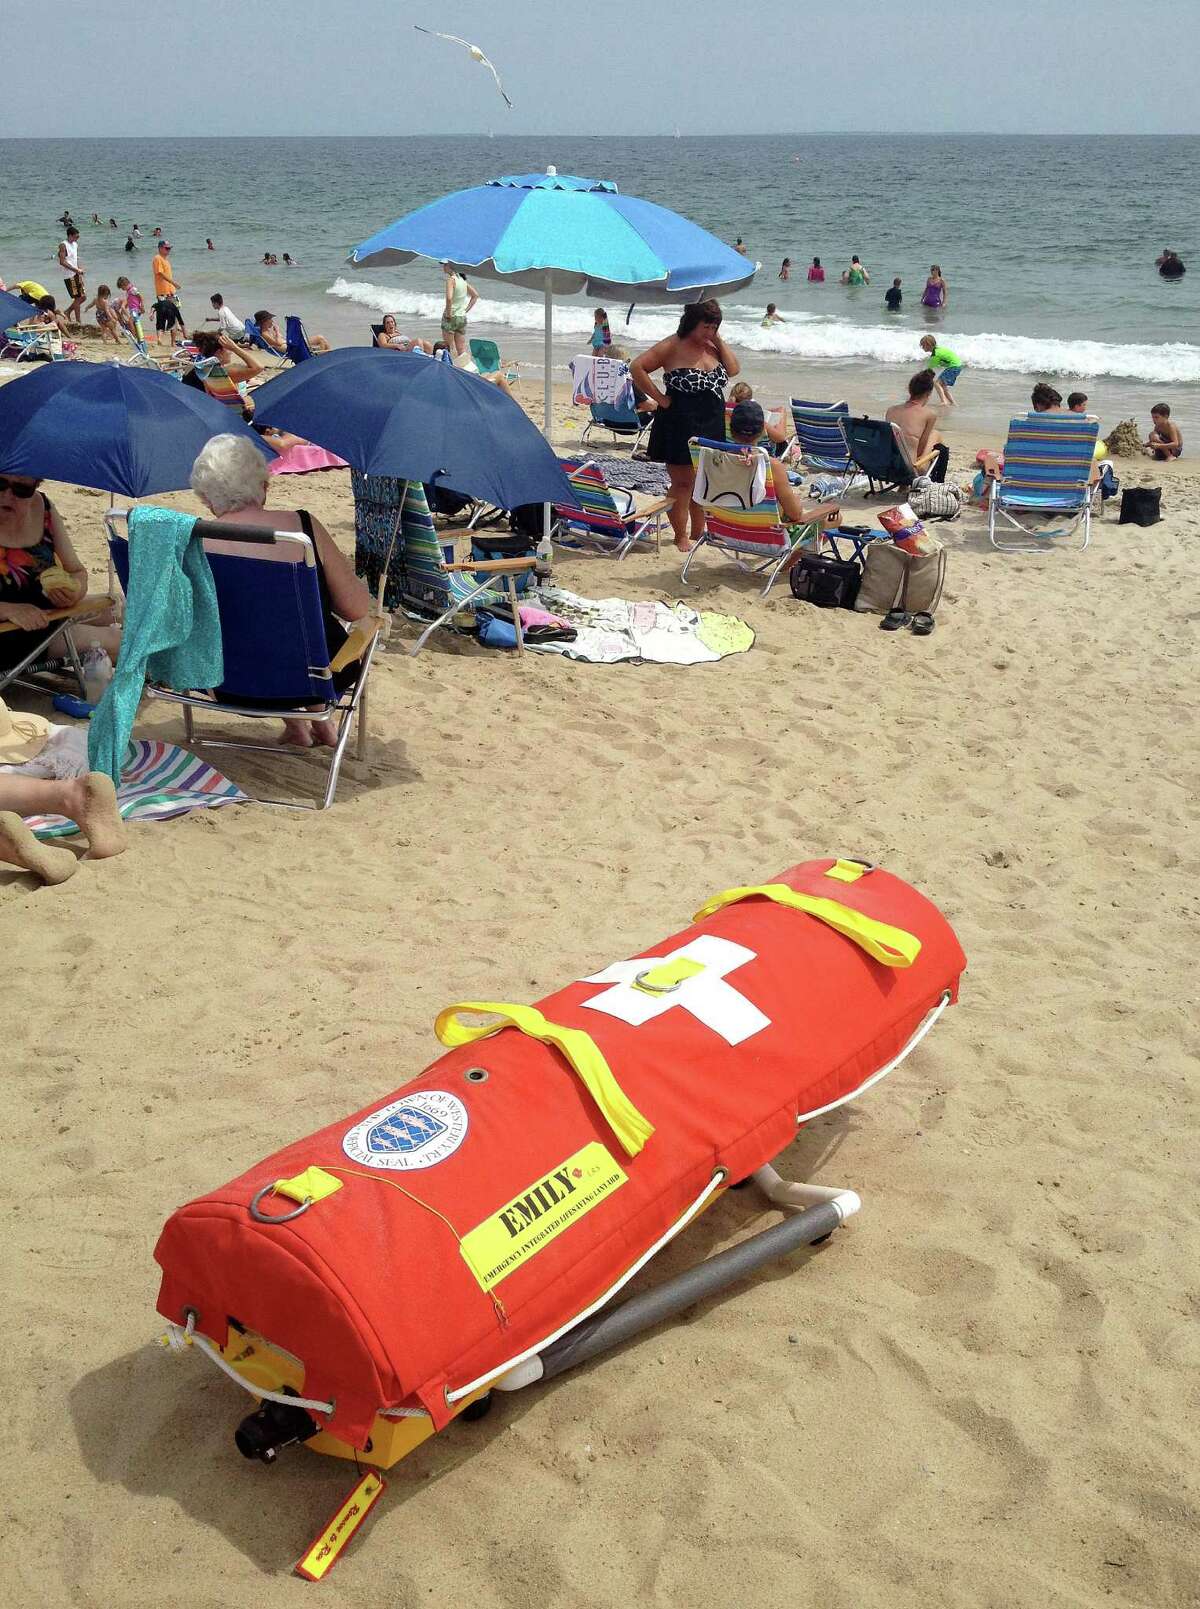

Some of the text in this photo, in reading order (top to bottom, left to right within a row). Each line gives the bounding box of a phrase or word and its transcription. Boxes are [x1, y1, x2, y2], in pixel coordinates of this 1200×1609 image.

[377, 1157, 413, 1168] SEAL
[483, 1173, 620, 1283] EMERGENCY INTEGRATED LIFESAVING LANYARD
[498, 1166, 576, 1238] EMILY
